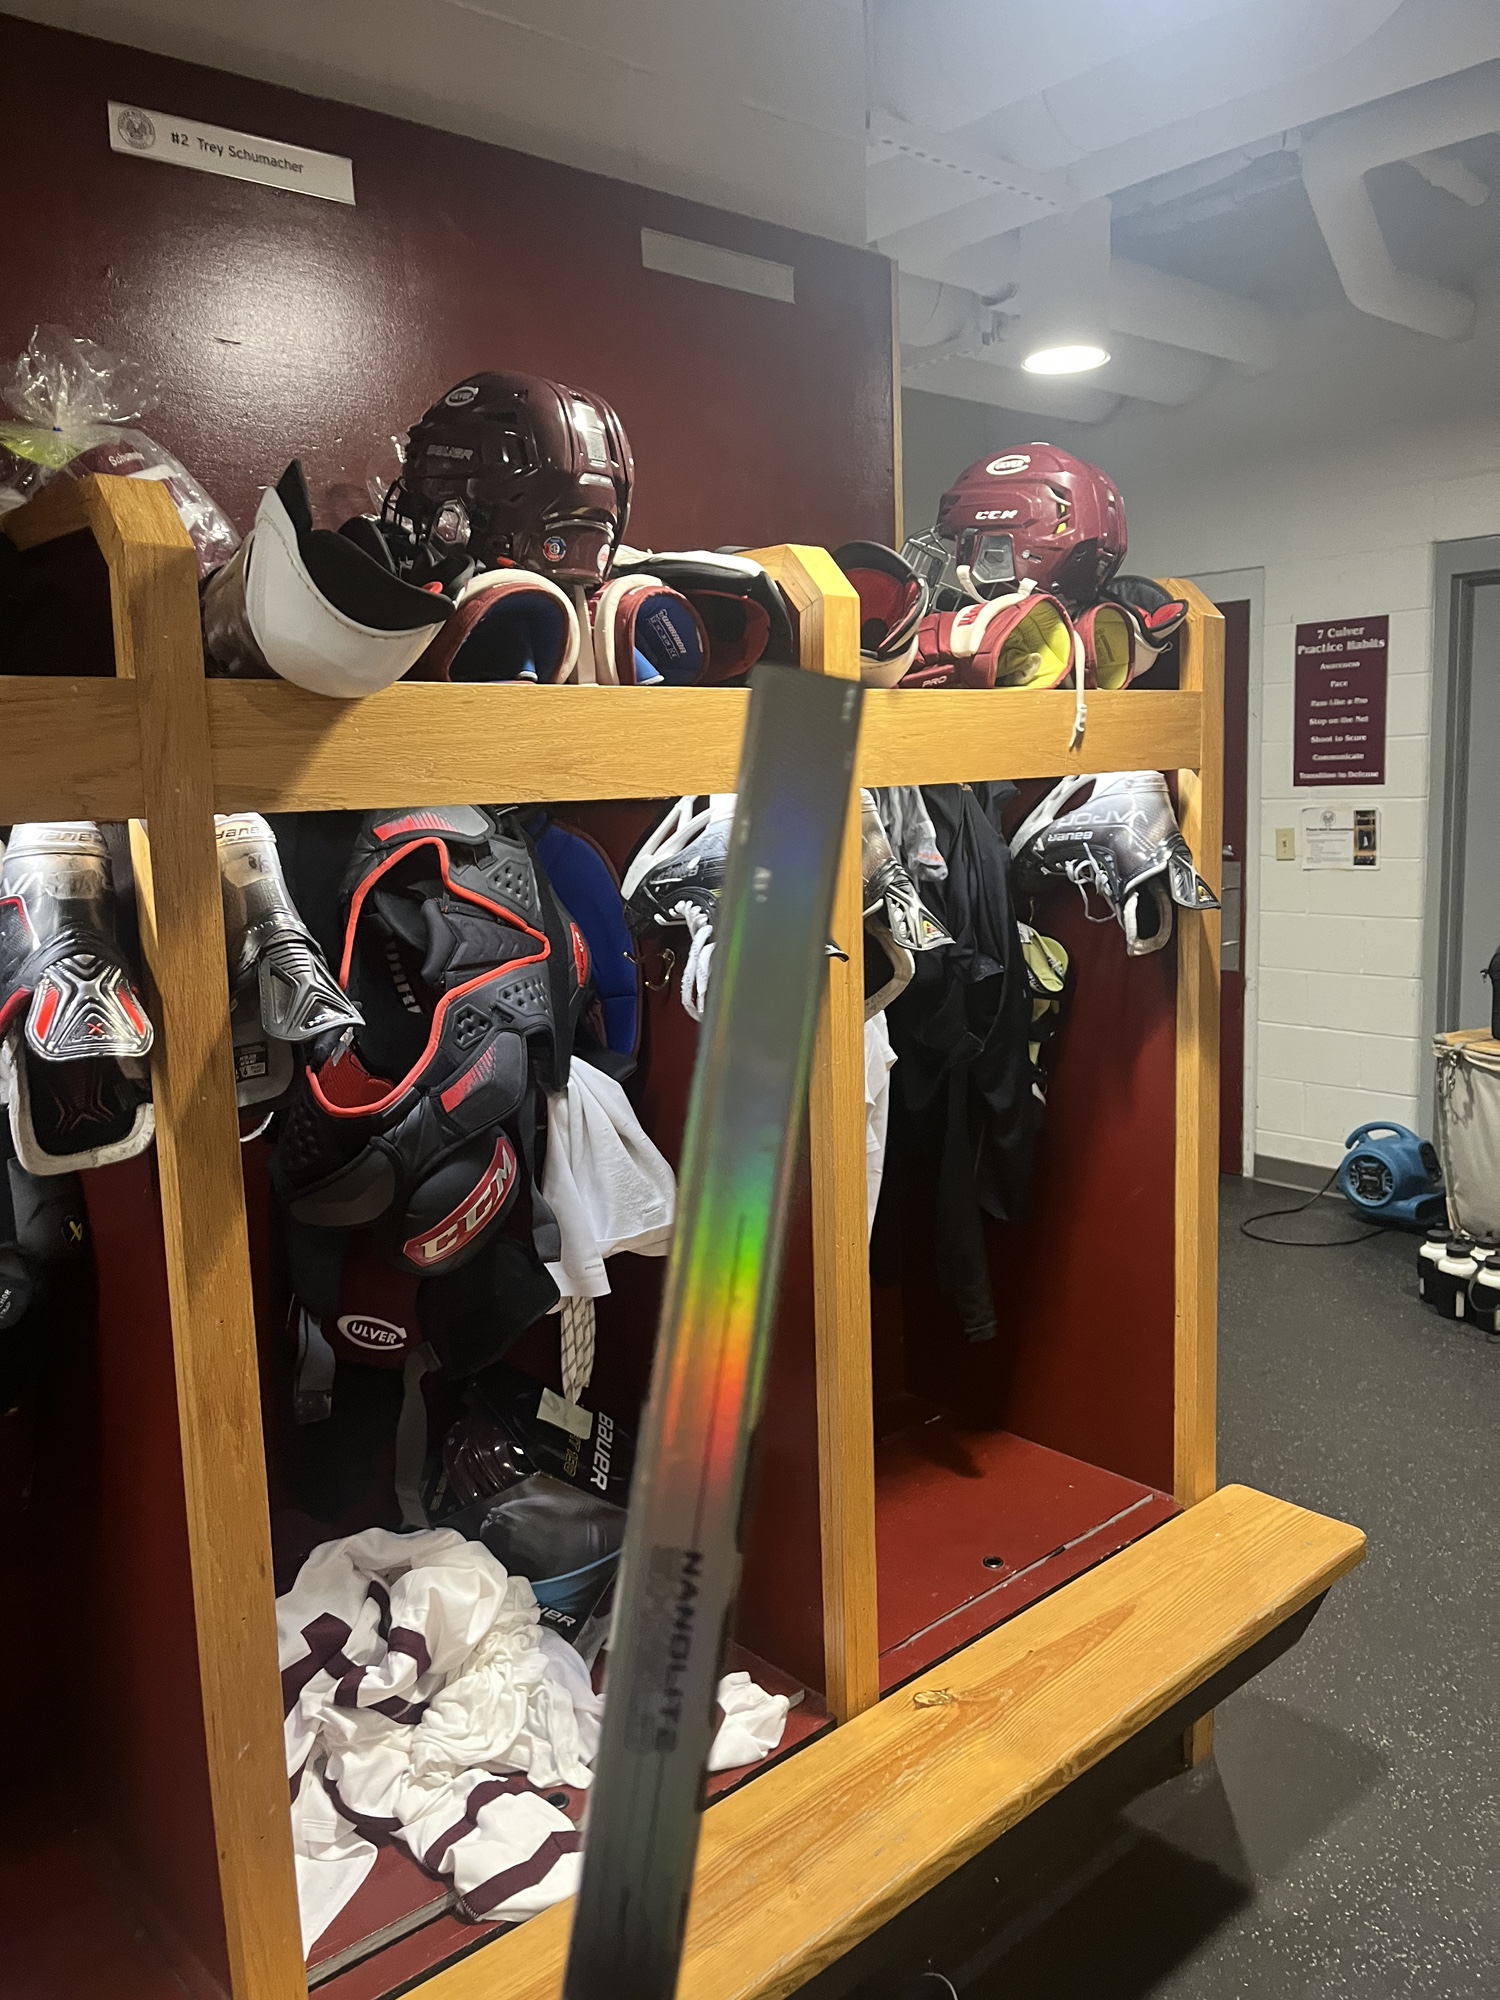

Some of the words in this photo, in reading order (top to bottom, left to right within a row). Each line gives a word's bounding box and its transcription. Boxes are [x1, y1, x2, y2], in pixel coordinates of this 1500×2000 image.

[170, 131, 190, 147] #2
[197, 137, 224, 157] Trey
[228, 146, 305, 174] Schumacher
[975, 509, 1019, 520] CCM
[1317, 629, 1325, 640] 7
[1327, 627, 1365, 638] Culver
[1297, 642, 1344, 655] Practice
[1346, 638, 1385, 650] Habits
[921, 675, 948, 688] PRO
[1330, 680, 1348, 688] Pace
[1345, 734, 1367, 742] Score
[1312, 753, 1365, 761] Communicate
[1057, 810, 1148, 829] VAPOR
[1047, 830, 1094, 842] BAUER
[421, 1145, 513, 1259] CCM
[590, 1411, 614, 1492] BAUER
